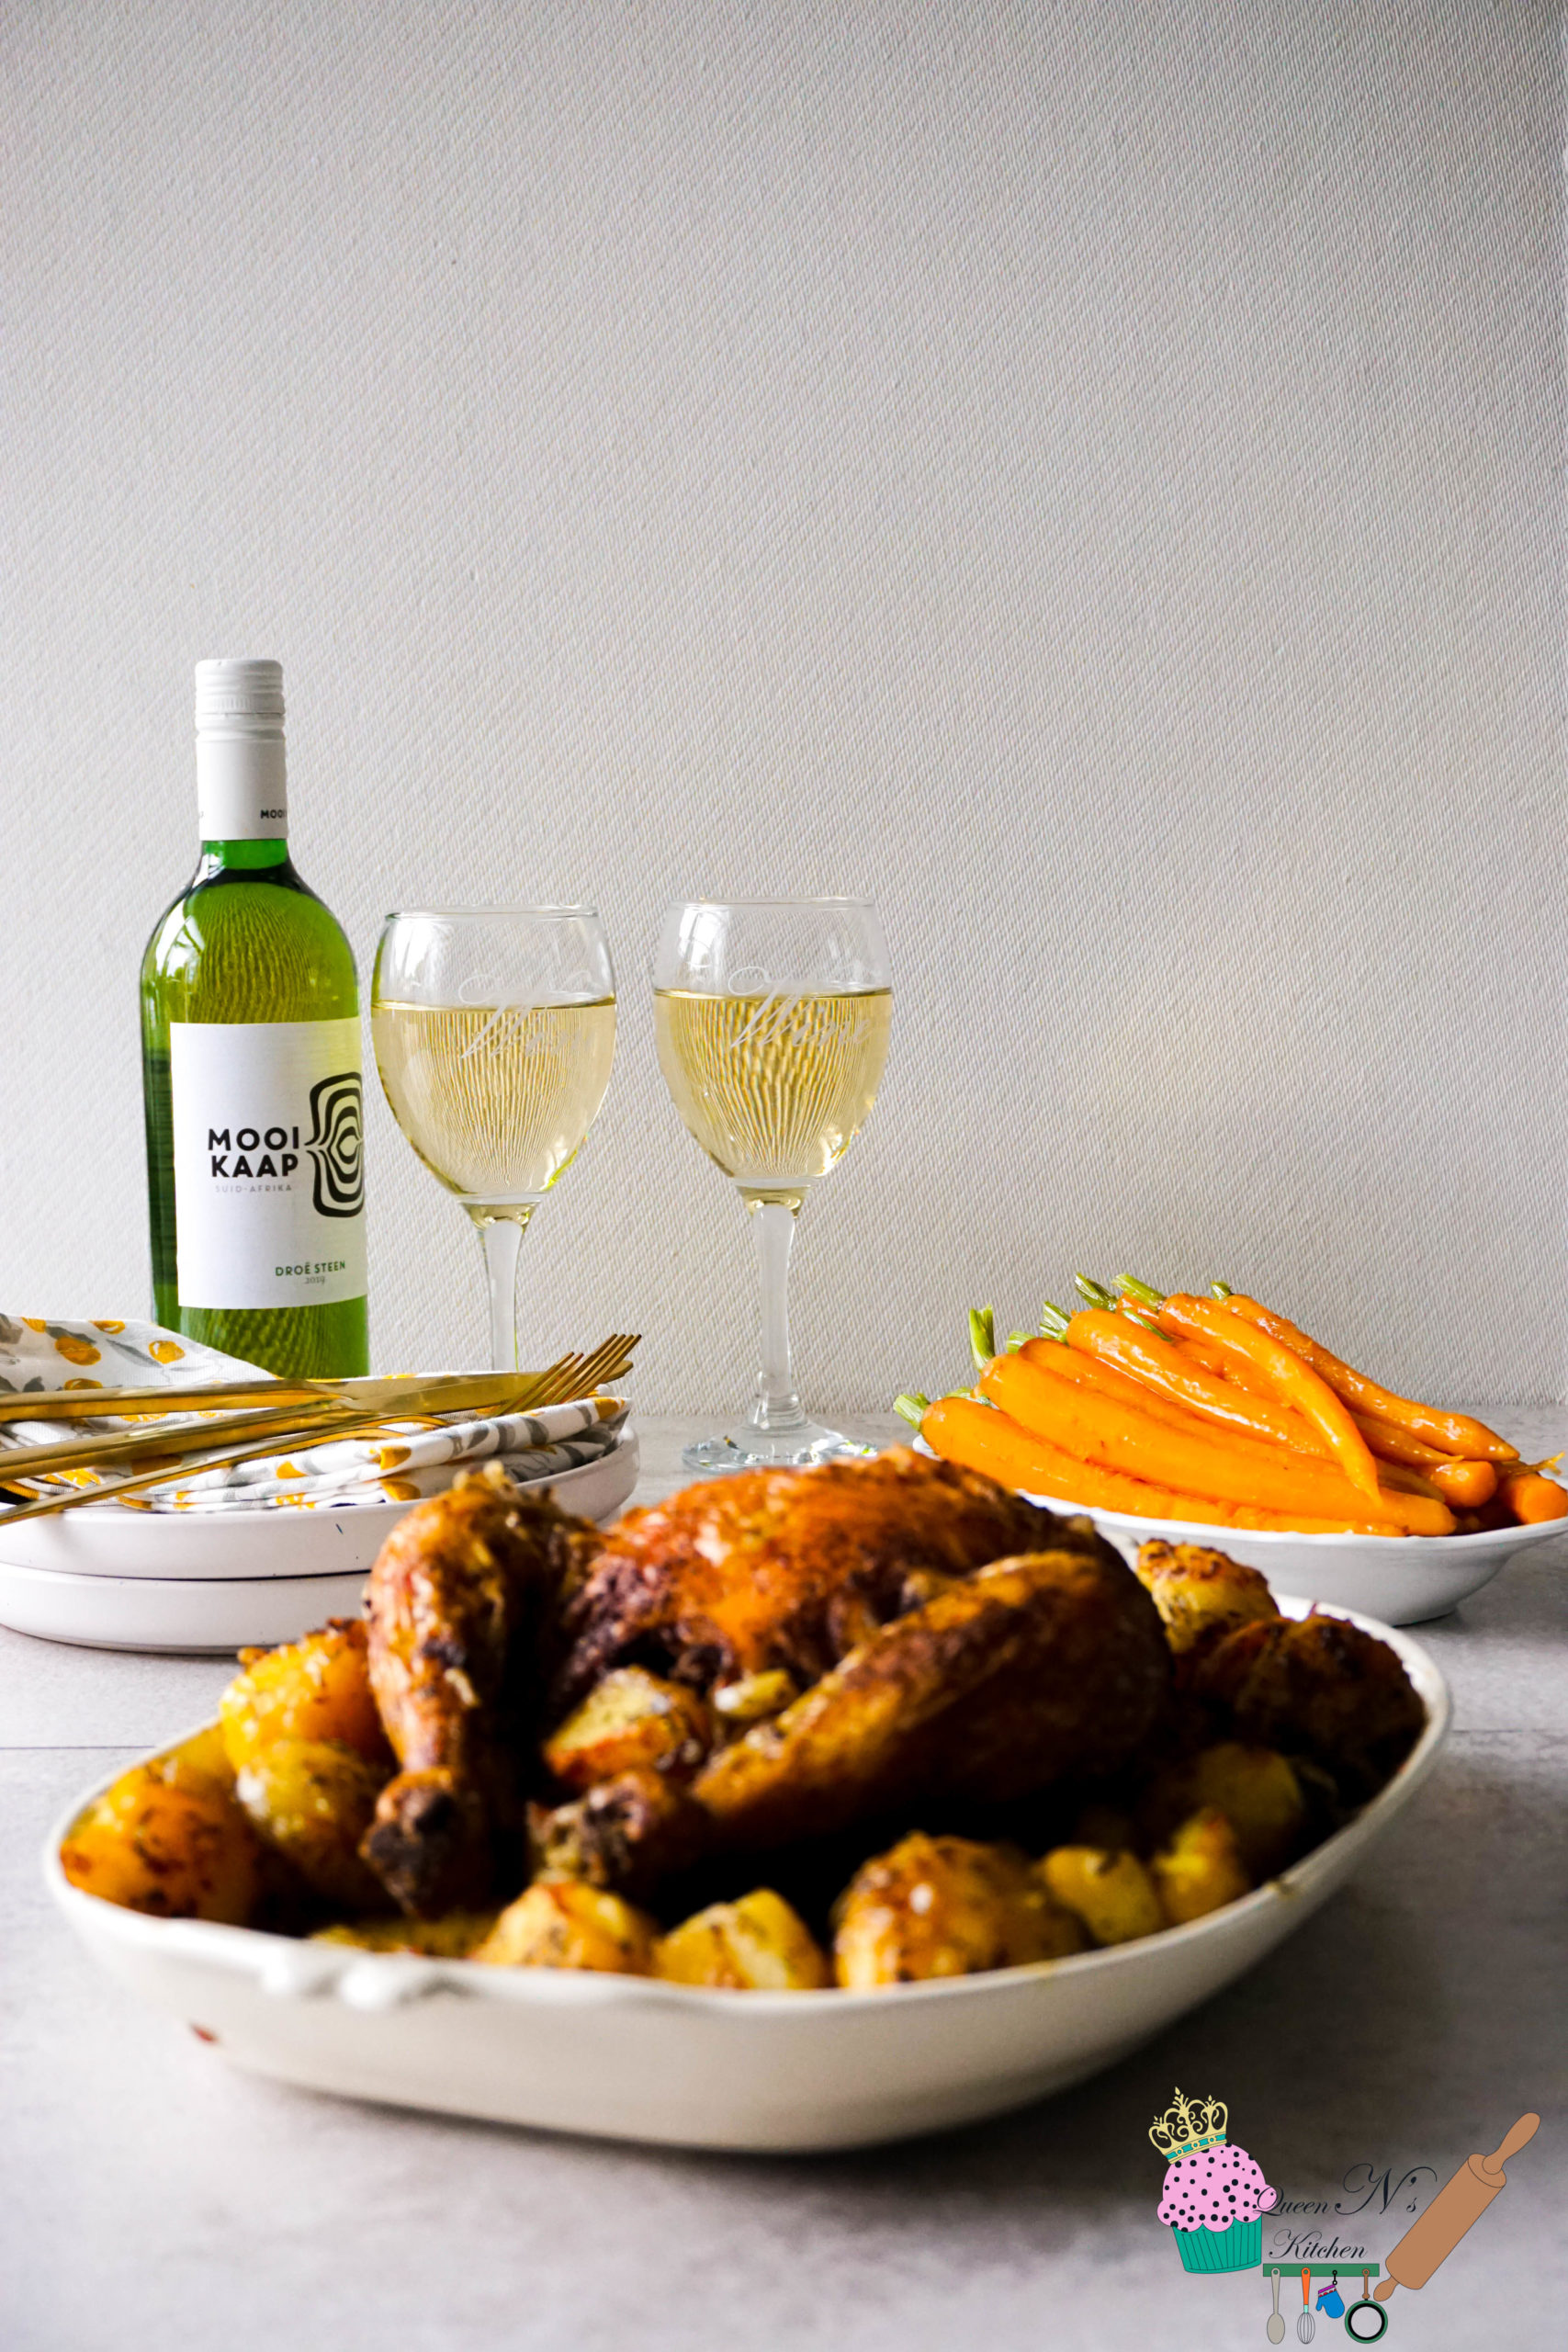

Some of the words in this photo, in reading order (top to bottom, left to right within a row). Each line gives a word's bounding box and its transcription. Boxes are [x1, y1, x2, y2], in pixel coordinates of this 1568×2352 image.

[208, 1126, 299, 1150] MOOI
[211, 1153, 299, 1177] KAAP
[215, 1184, 292, 1193] SUID-AFRIKA
[276, 1261, 310, 1276] DROË
[314, 1261, 345, 1273] STEEN
